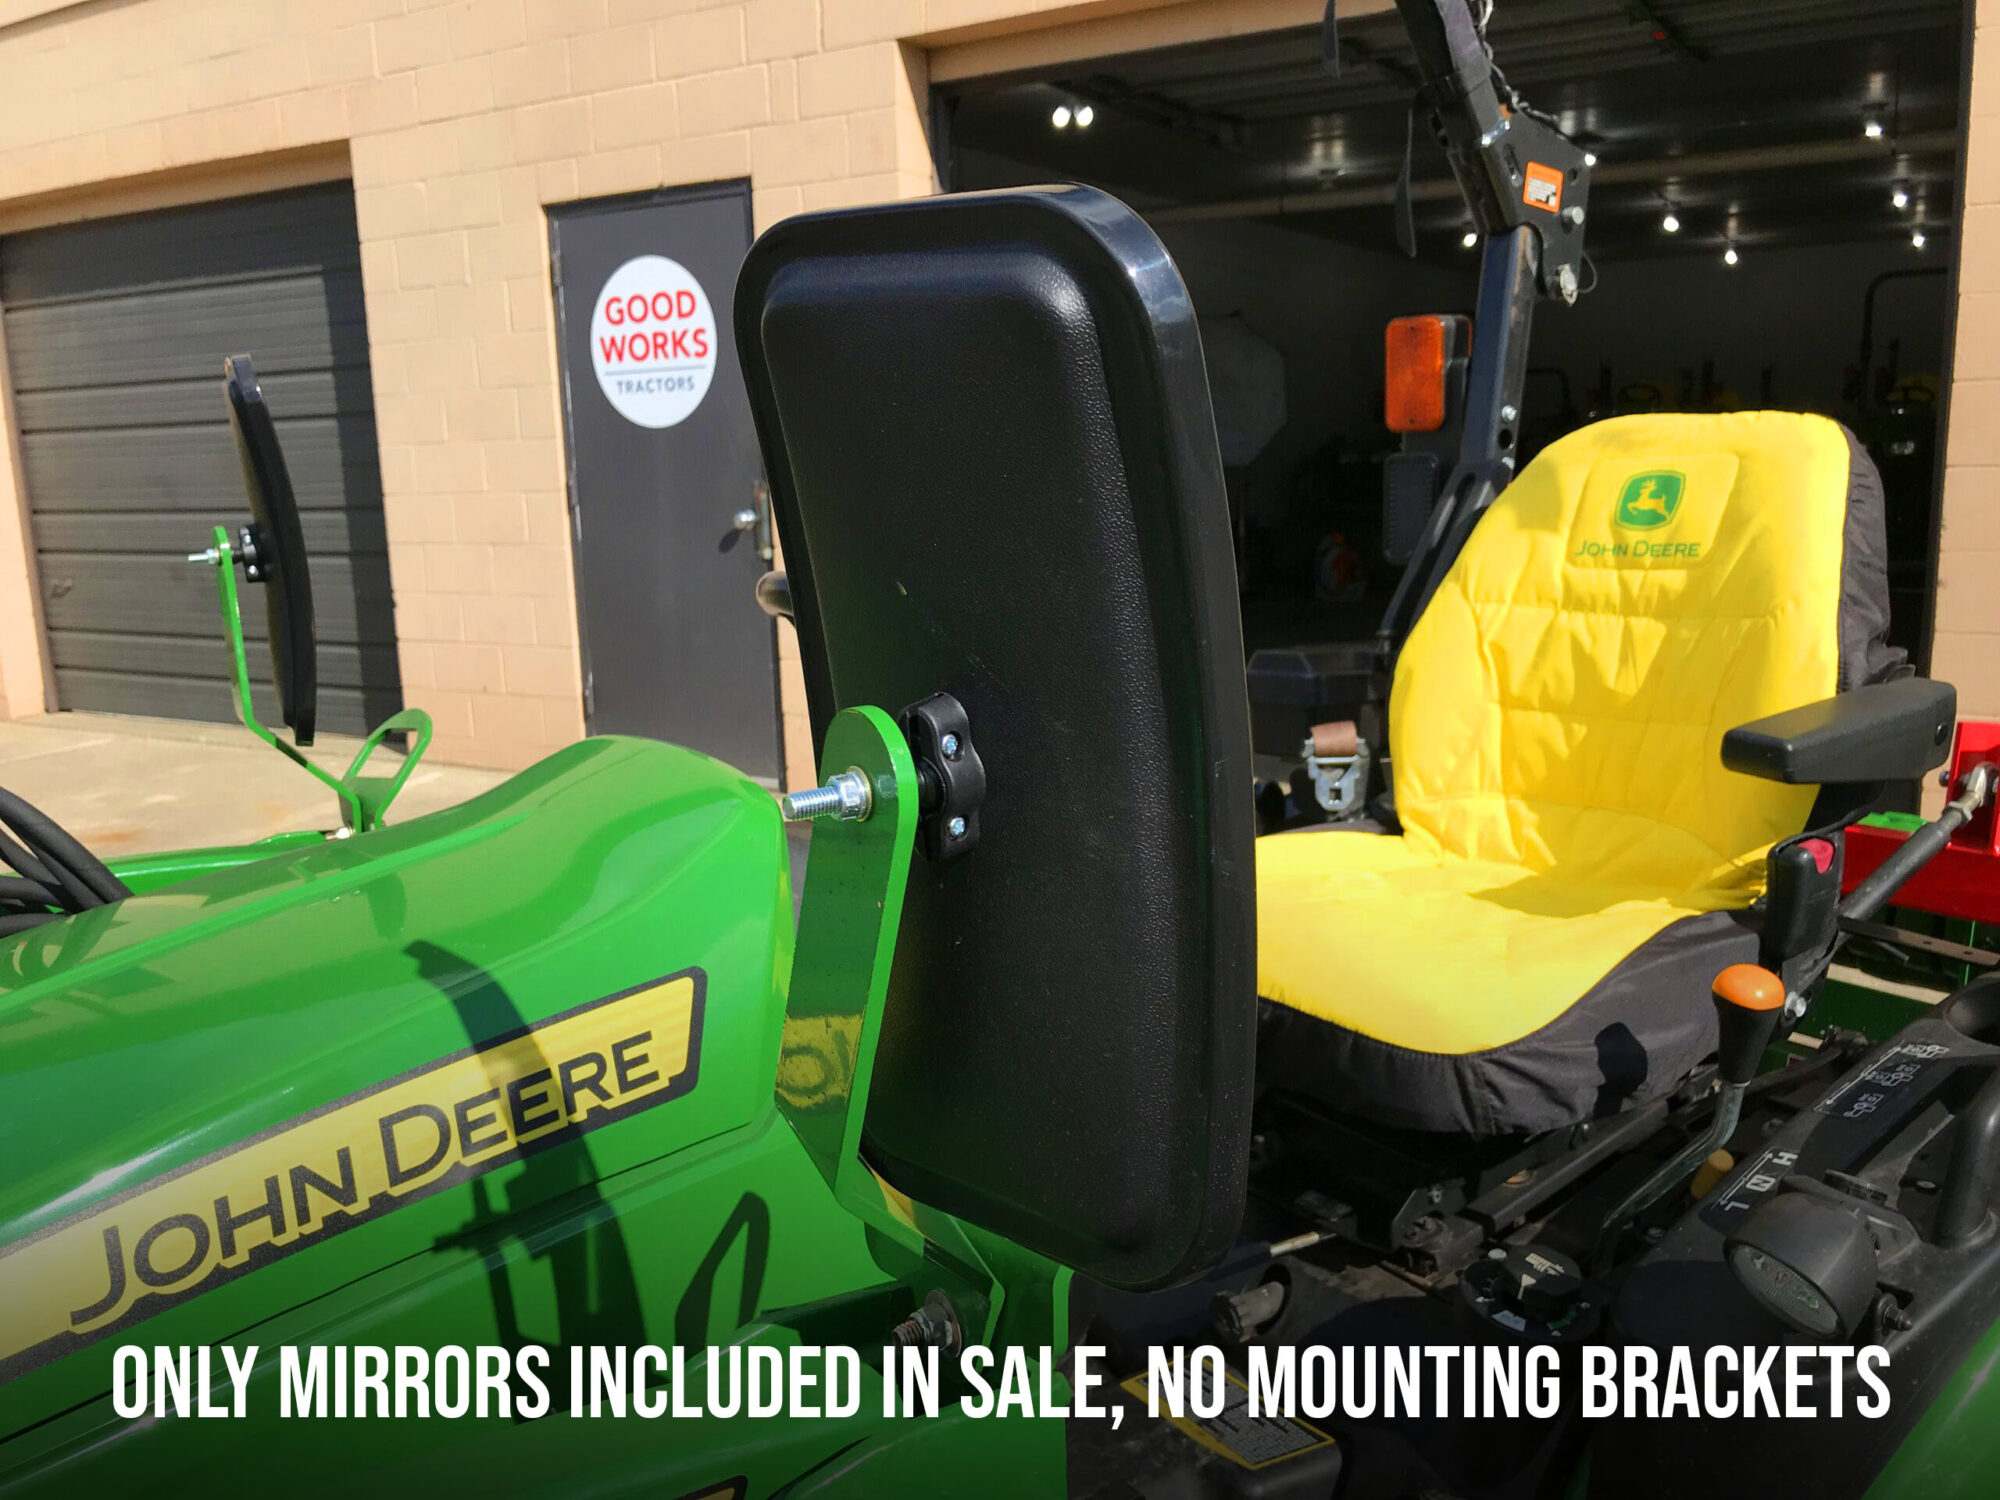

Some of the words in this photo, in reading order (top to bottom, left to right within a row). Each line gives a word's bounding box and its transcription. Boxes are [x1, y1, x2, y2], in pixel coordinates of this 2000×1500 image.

[604, 290, 696, 325] GOOD
[600, 328, 708, 364] WORKS
[616, 375, 695, 396] TRACTORS
[1575, 539, 1629, 557] JOHN
[1632, 540, 1701, 558] DEERE
[69, 1147, 359, 1328] JOHN
[378, 1030, 660, 1186] DEERE
